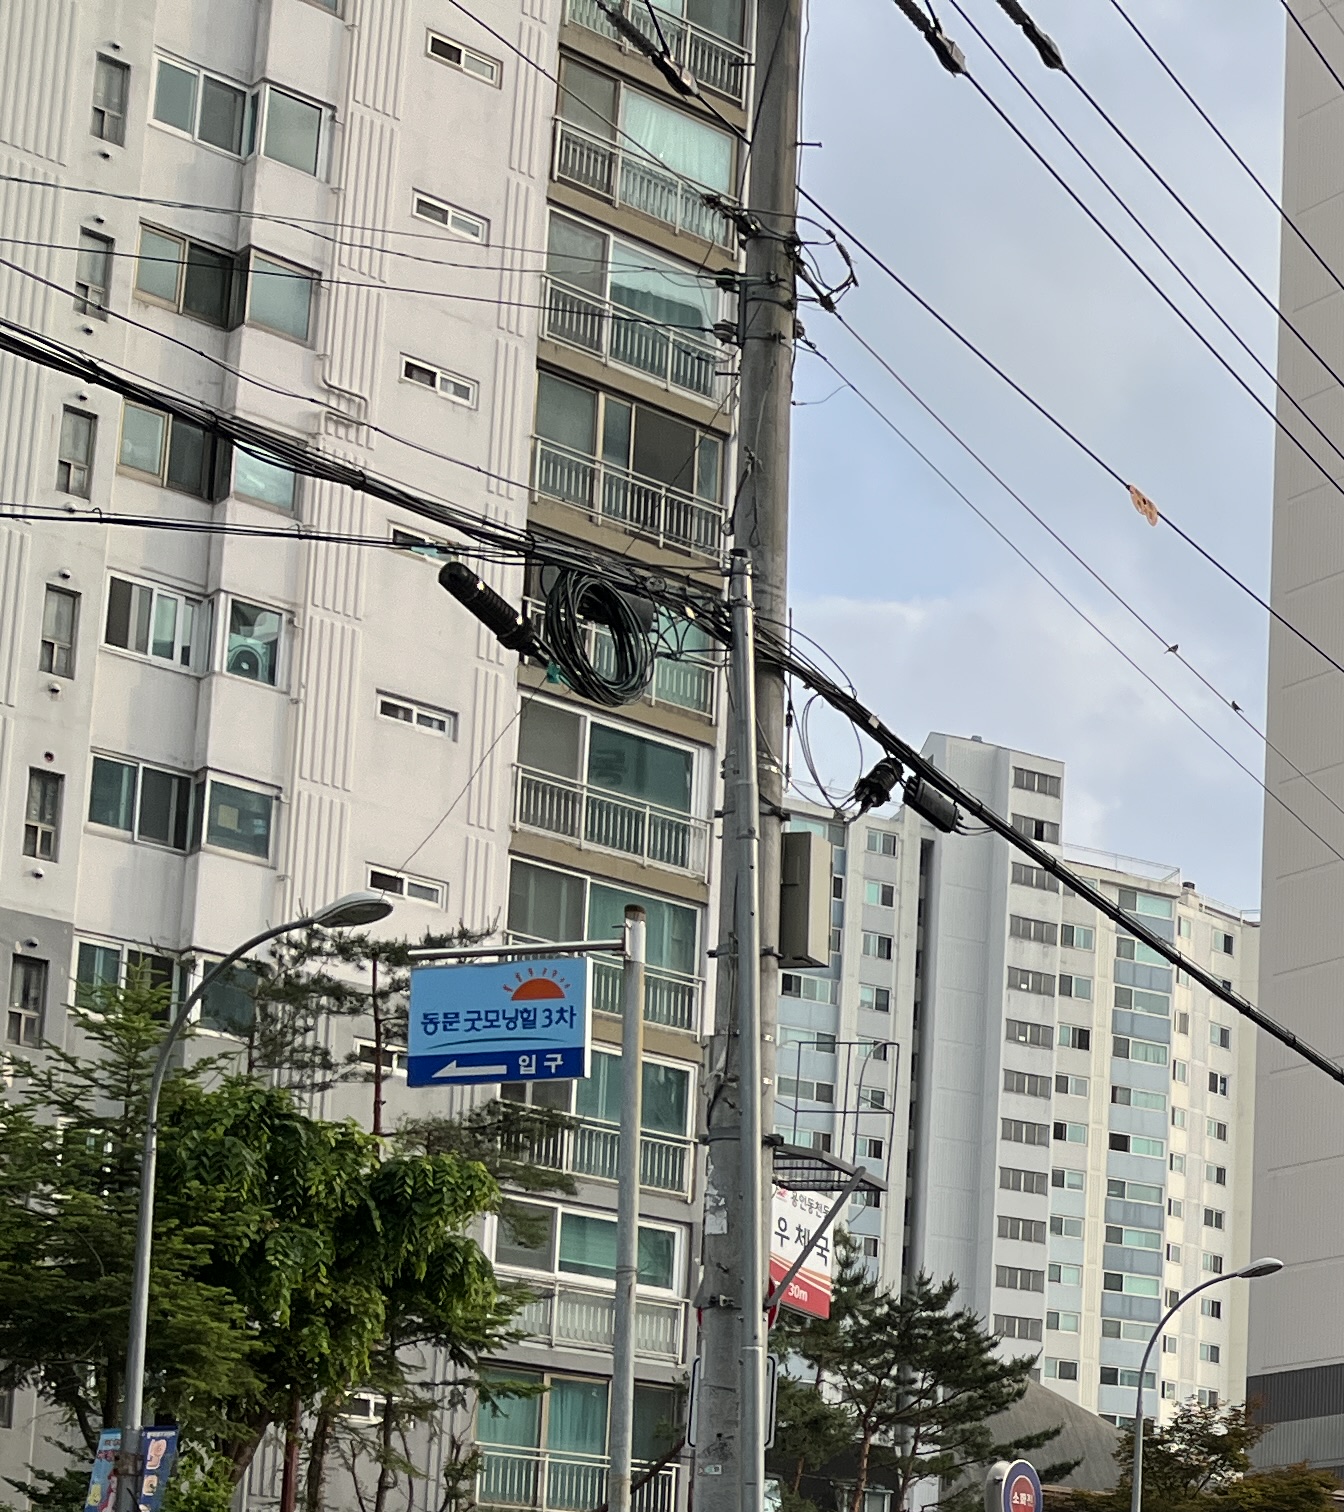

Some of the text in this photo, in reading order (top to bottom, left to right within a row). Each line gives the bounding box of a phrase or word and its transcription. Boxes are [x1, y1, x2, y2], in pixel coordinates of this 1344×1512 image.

[421, 1004, 577, 1036] 동문 굿모닝힐 3차
[518, 1053, 564, 1075] 입구
[774, 1216, 830, 1267] 우체국
[788, 1282, 808, 1302] 30m
